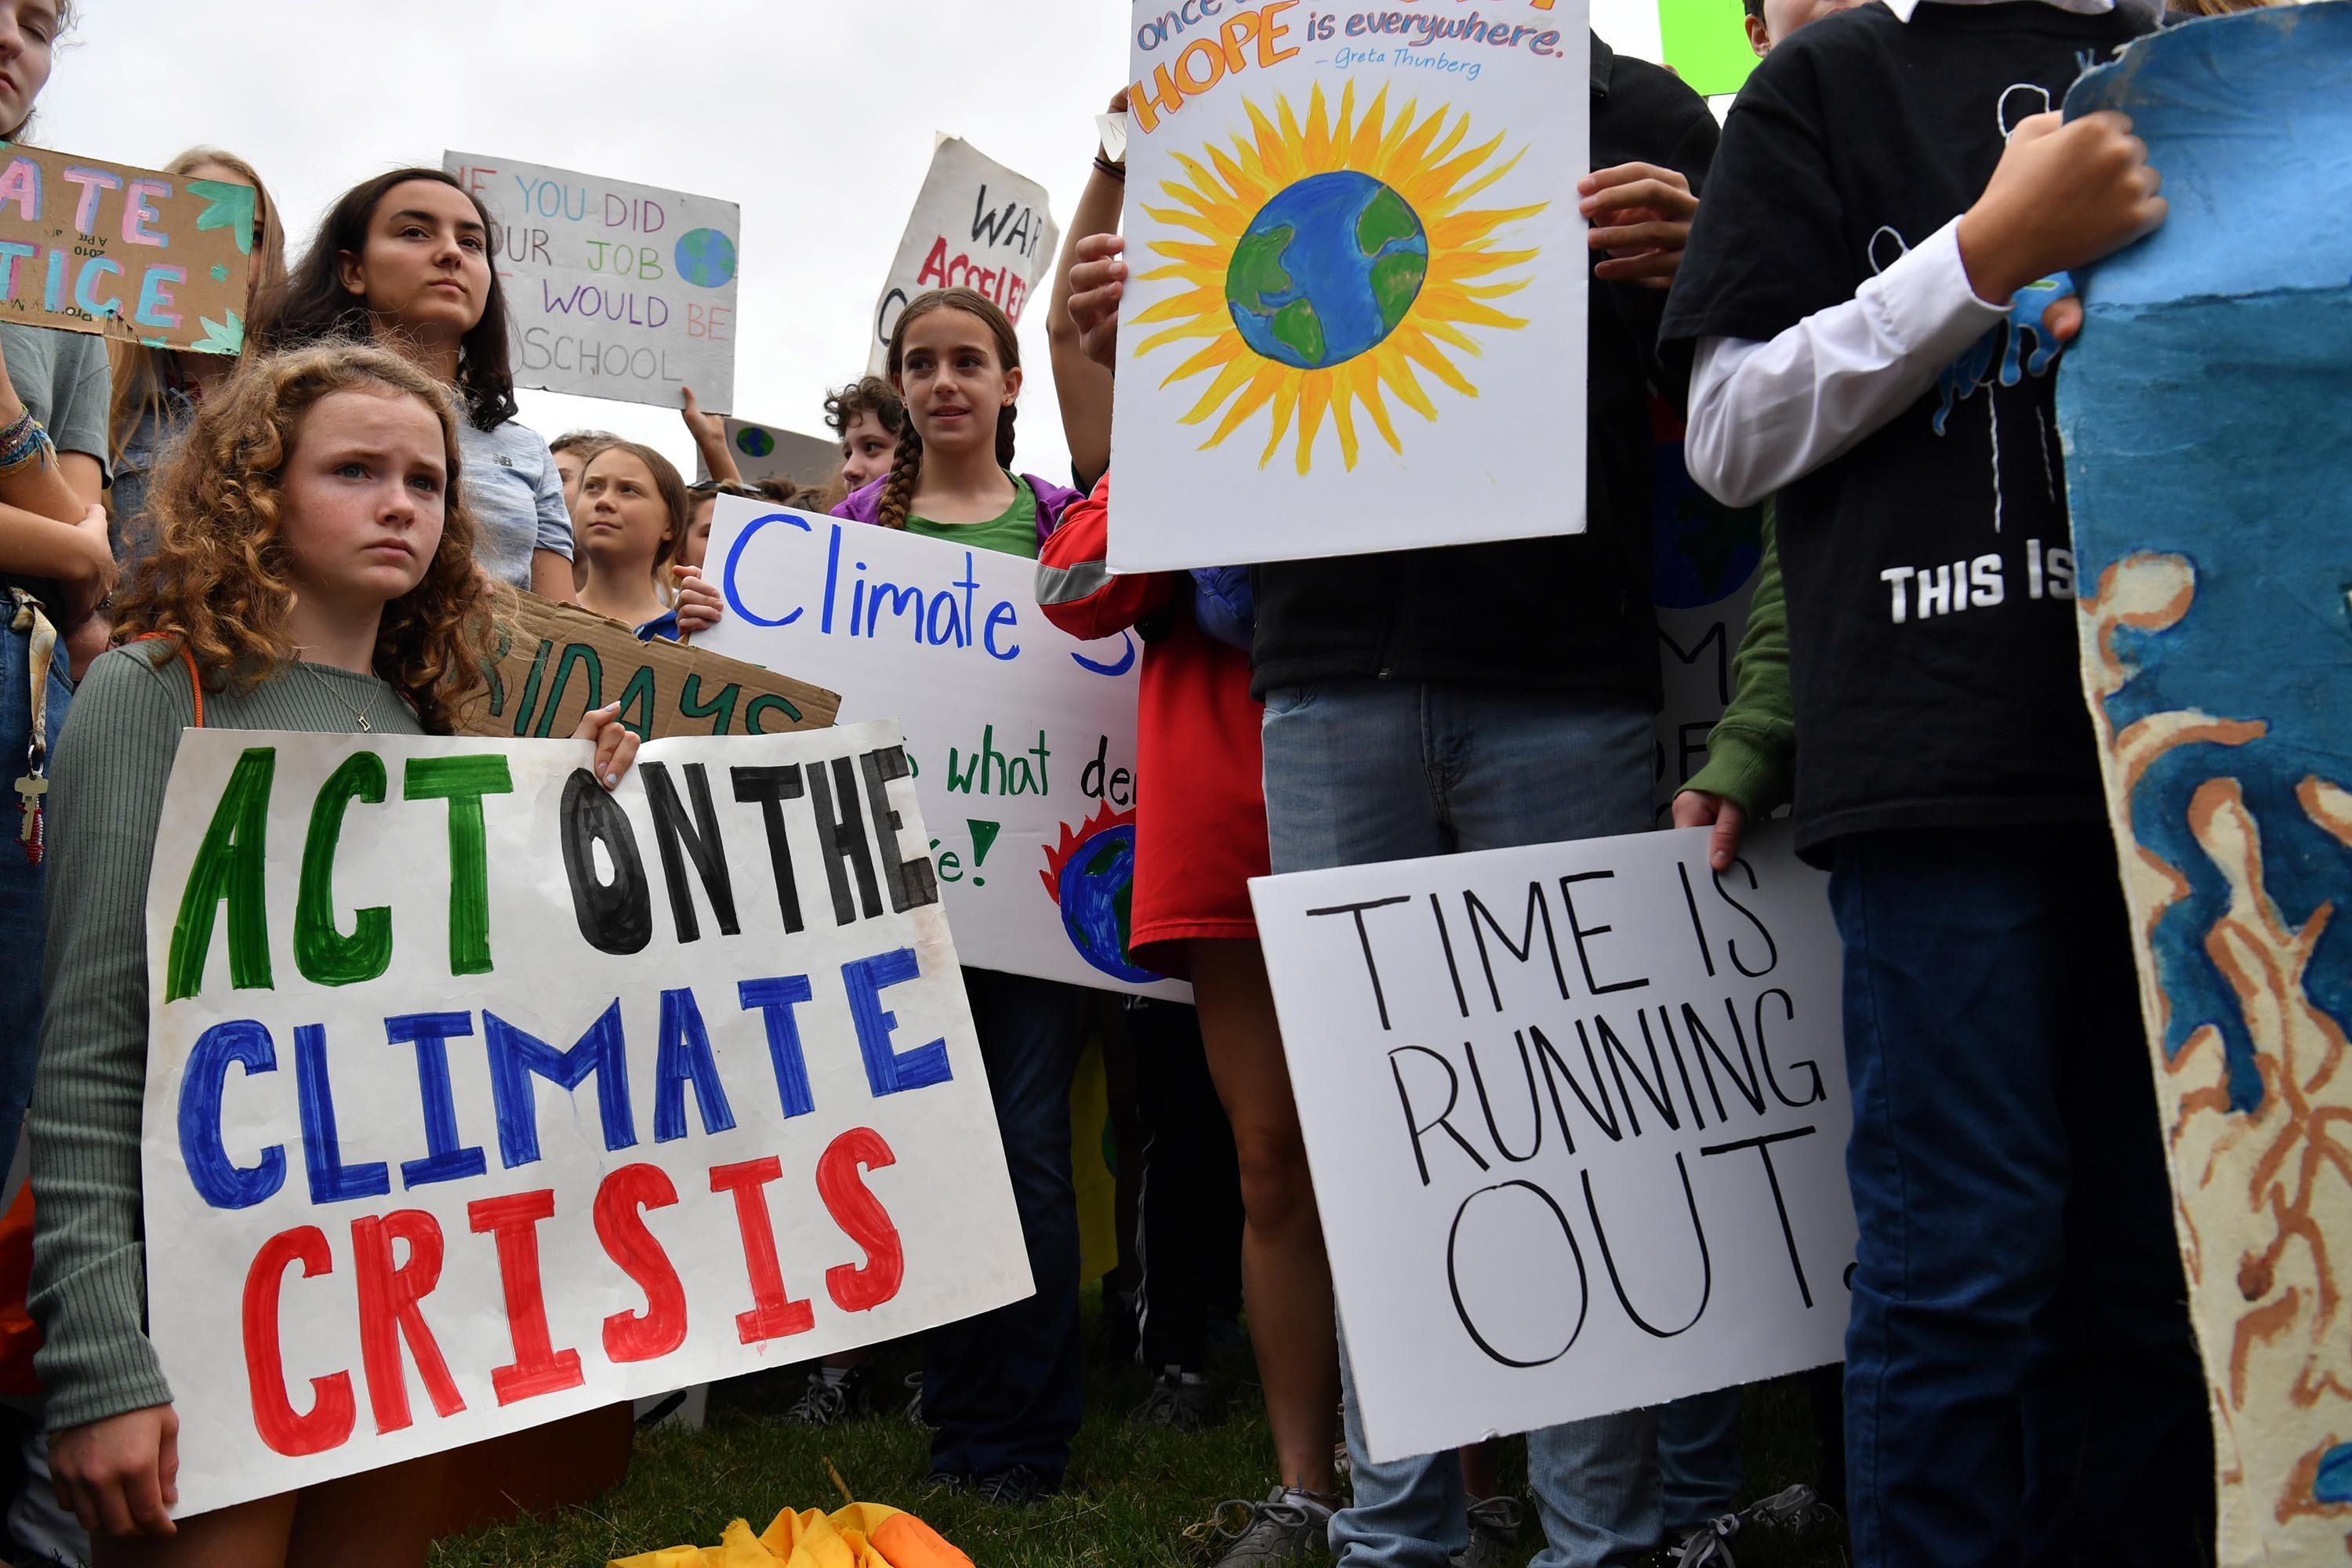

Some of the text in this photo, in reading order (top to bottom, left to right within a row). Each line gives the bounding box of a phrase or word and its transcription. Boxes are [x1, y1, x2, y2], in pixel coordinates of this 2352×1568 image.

[1129, 0, 1300, 134] HOPE
[1307, 11, 1336, 42] is
[1345, 10, 1563, 59] everywhere.
[1137, 0, 1223, 51] once
[1394, 49, 1481, 81] Thunberg
[516, 175, 586, 221] YOU
[605, 194, 665, 233] DID
[586, 240, 664, 280] JOB
[543, 278, 731, 340] WOULD BE
[524, 327, 684, 381] SCHOOL
[723, 514, 1019, 660] Climate
[1880, 539, 2076, 624] THIS IS
[947, 724, 1051, 796] what
[165, 745, 939, 1004] ACT ON THE
[1306, 856, 1778, 1030] TIME IS
[177, 946, 953, 1210] CLIMATE
[1388, 988, 1828, 1186] RUNNING
[241, 1126, 906, 1457] CRISIS
